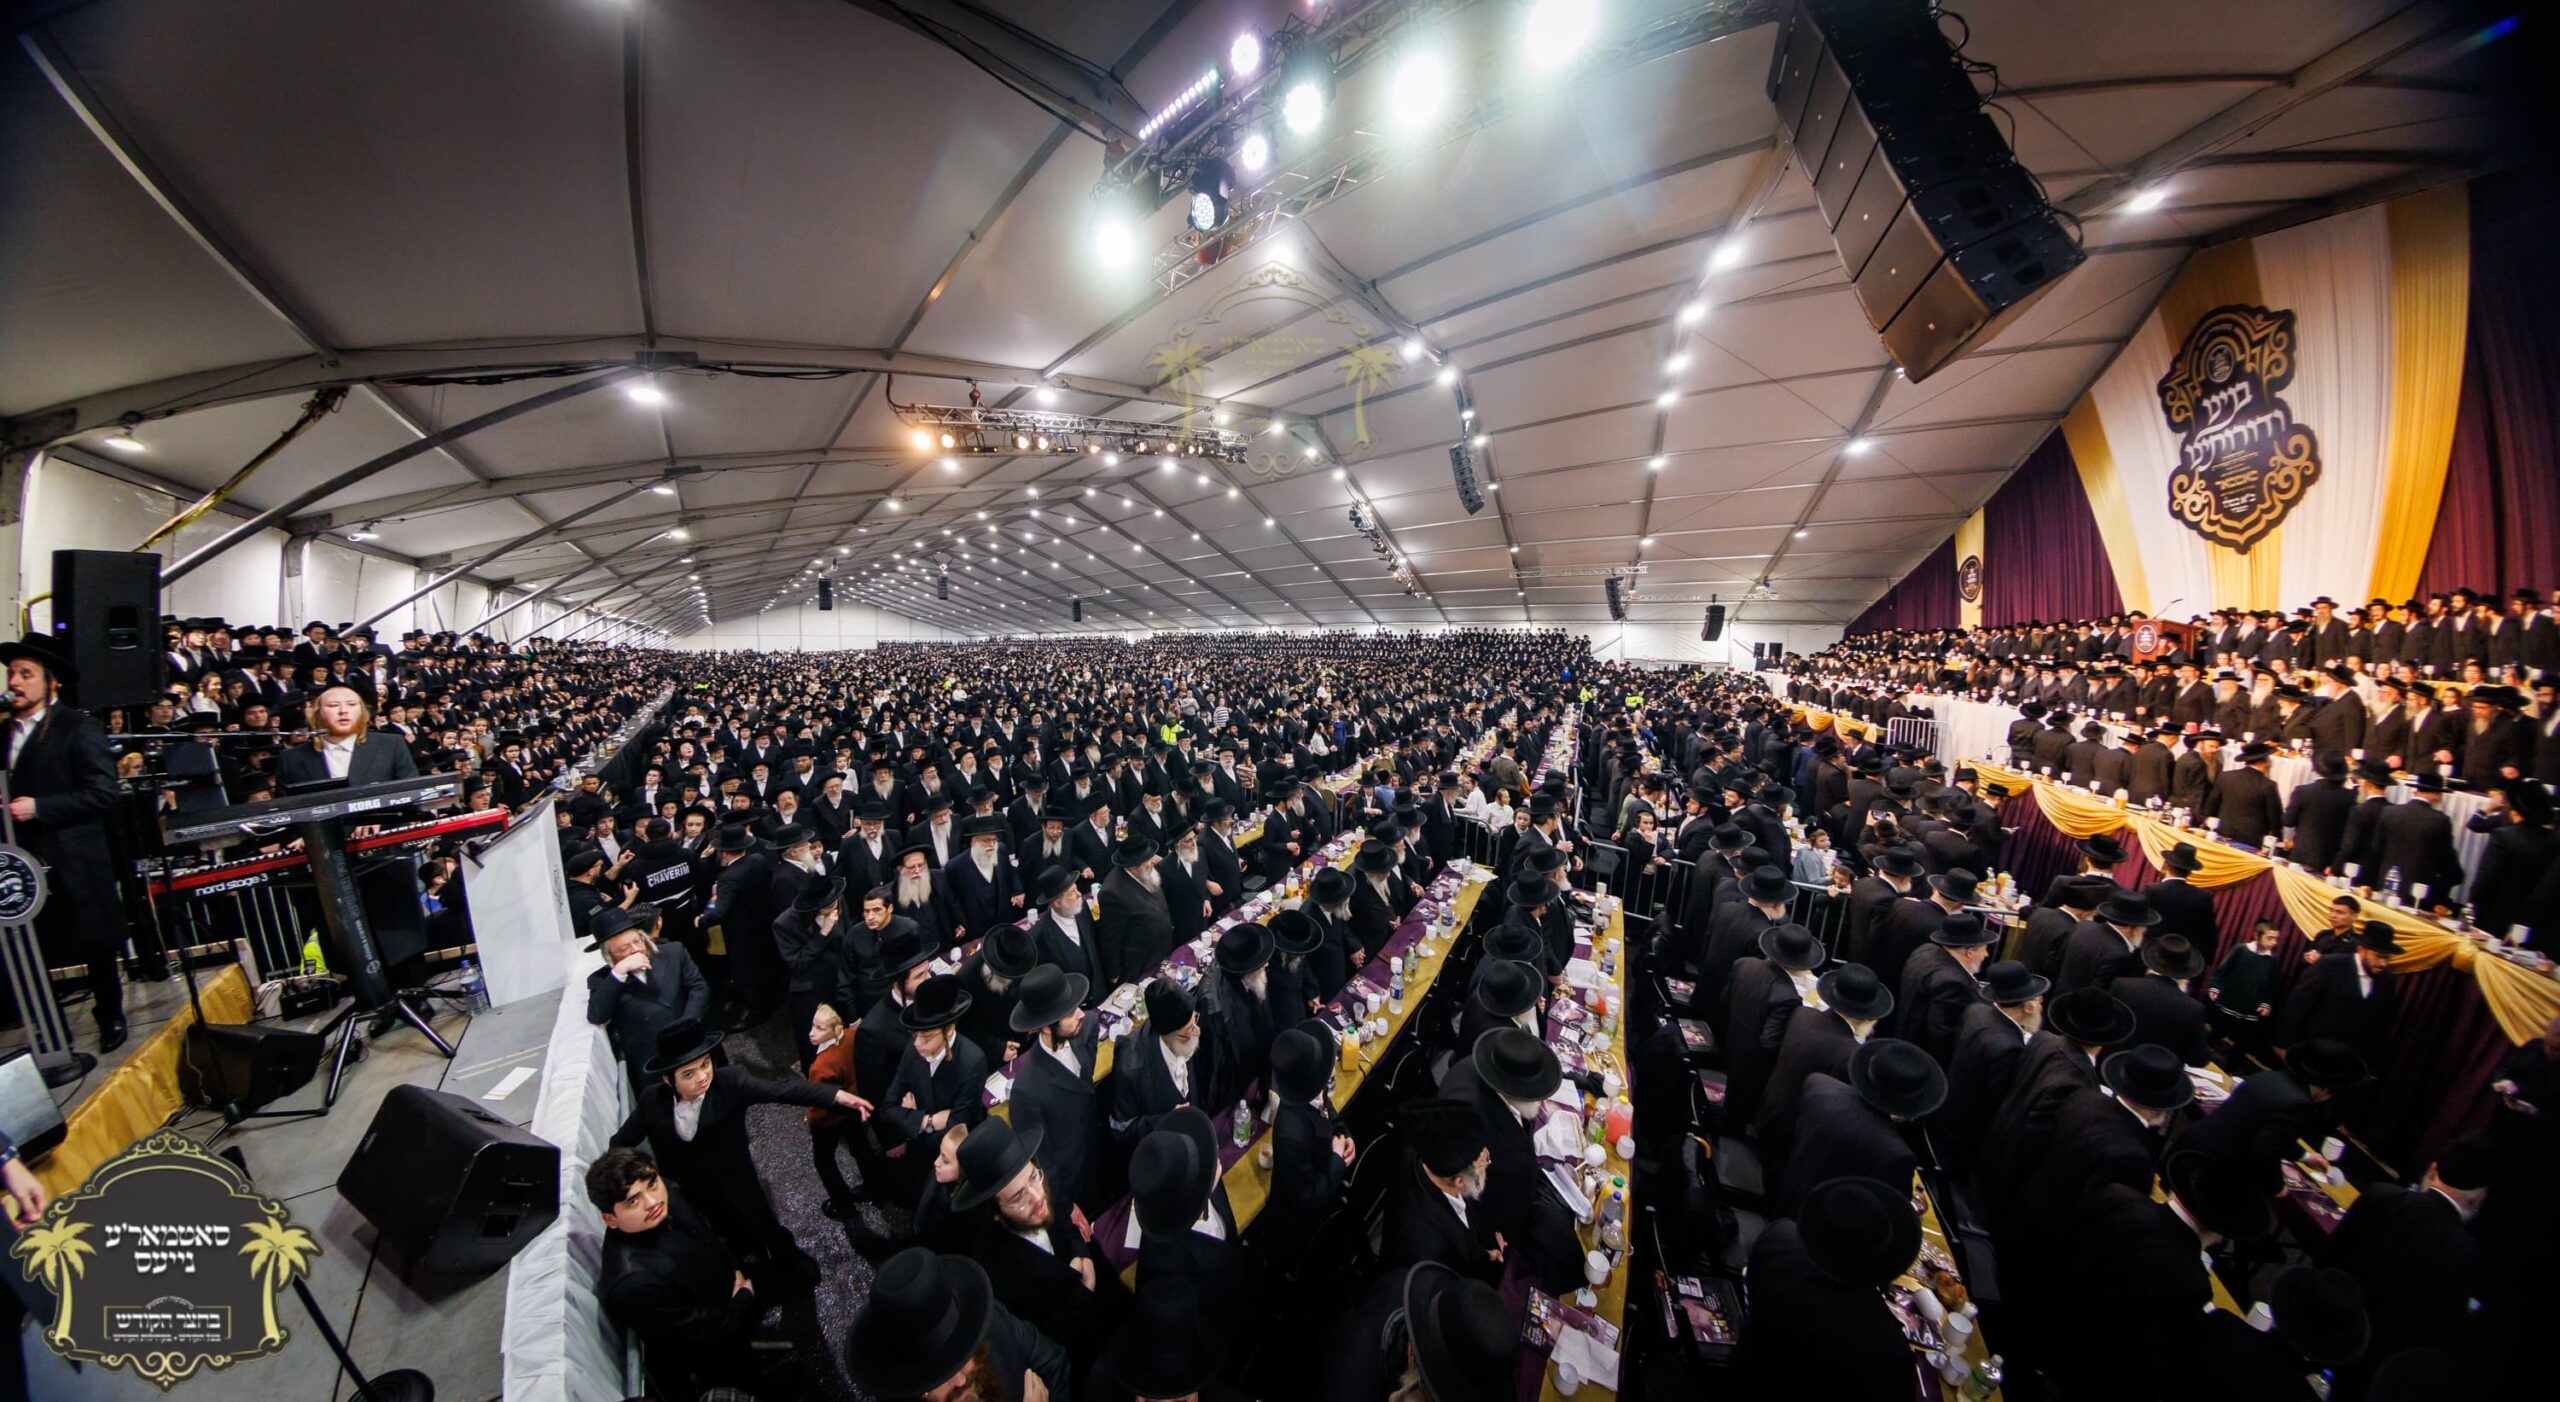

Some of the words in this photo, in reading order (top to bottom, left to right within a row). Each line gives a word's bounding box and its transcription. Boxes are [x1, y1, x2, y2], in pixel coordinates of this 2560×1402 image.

[348, 798, 381, 813] KORG
[195, 882, 226, 897] nord
[226, 875, 260, 889] stage
[260, 873, 269, 883] 3
[648, 864, 690, 887] CHAVERIM
